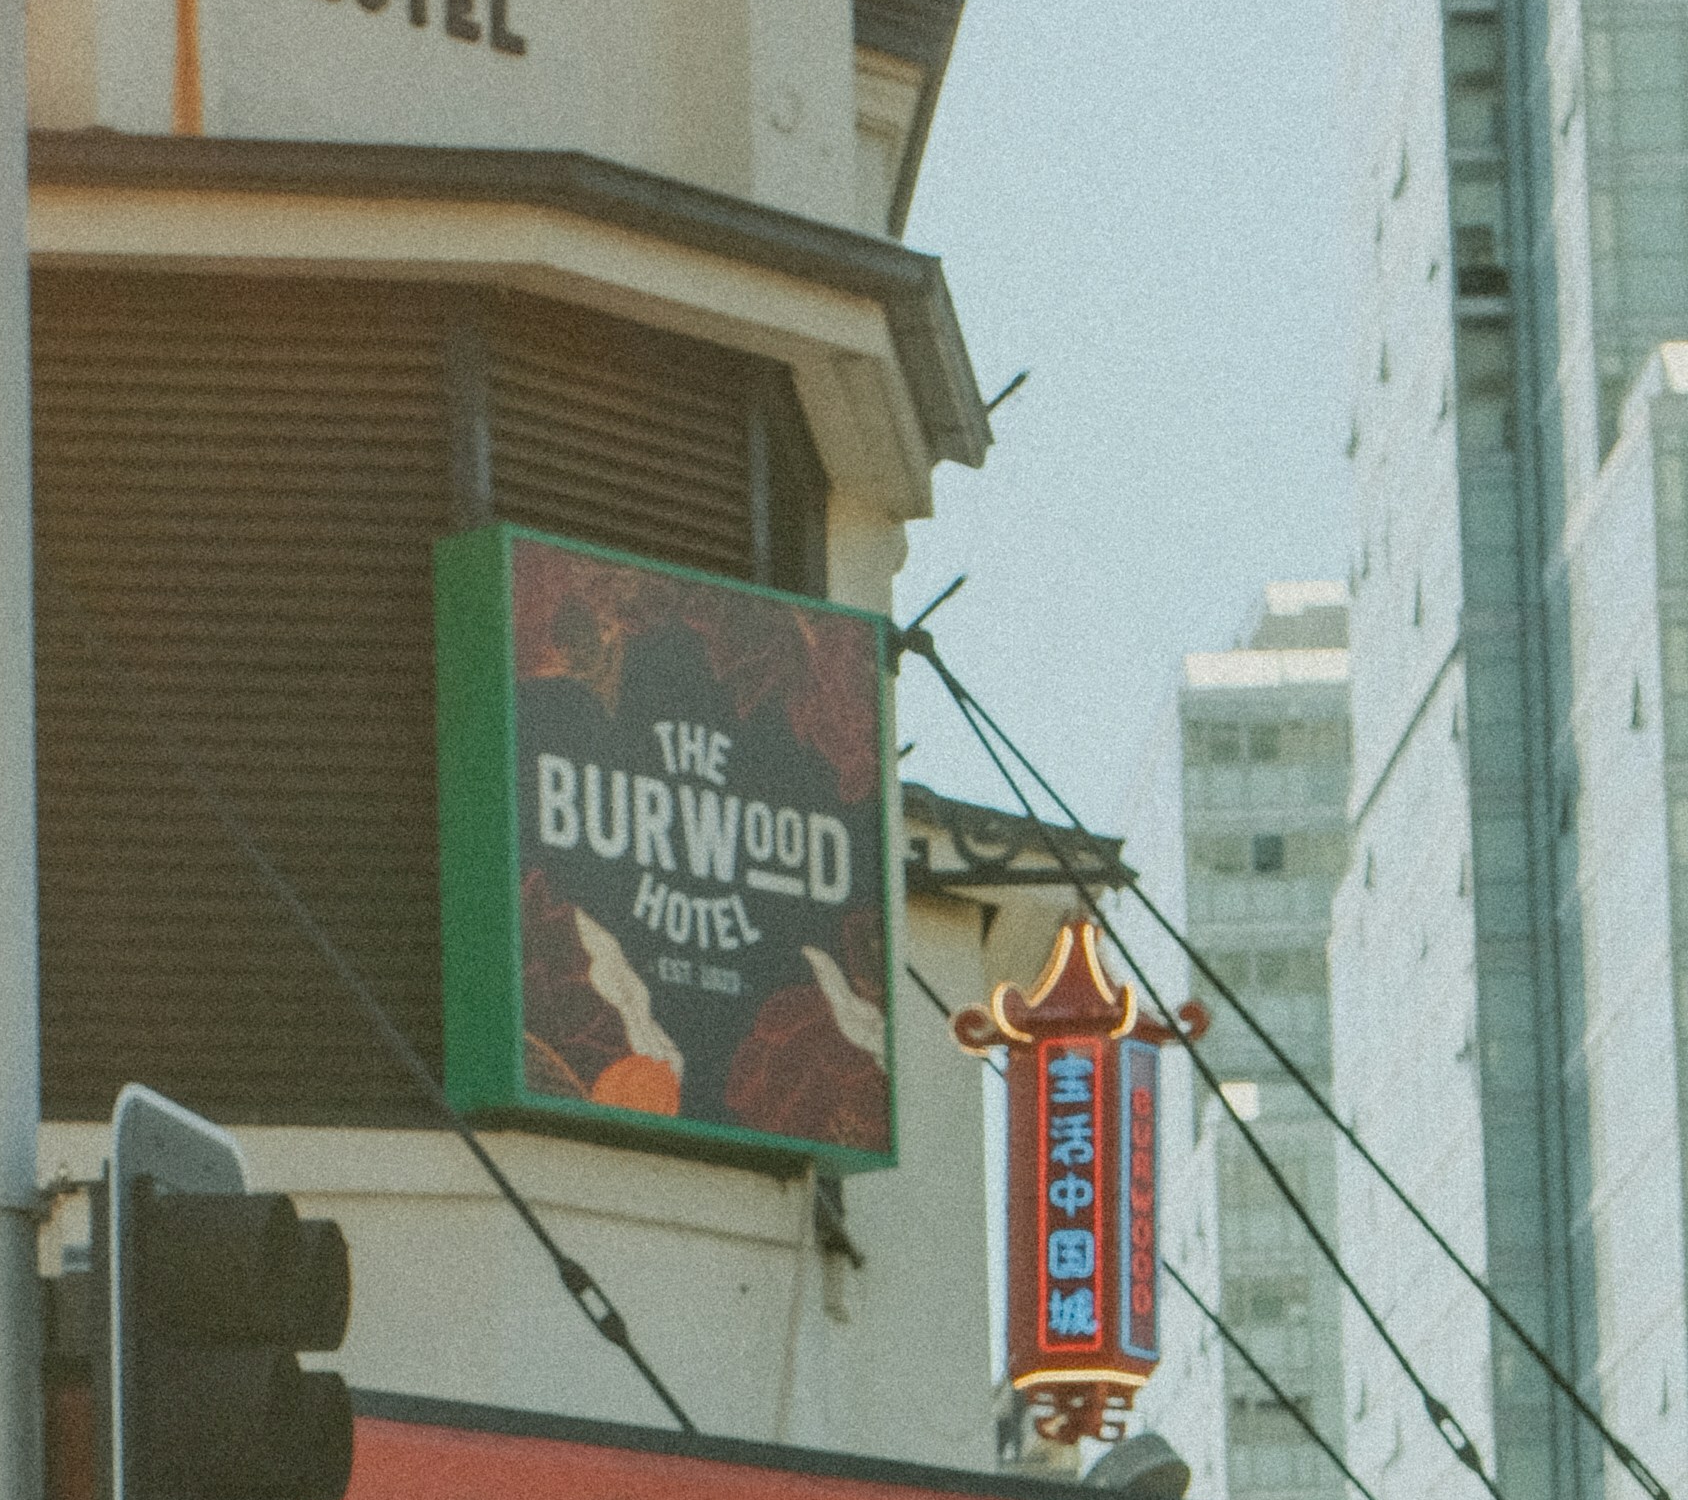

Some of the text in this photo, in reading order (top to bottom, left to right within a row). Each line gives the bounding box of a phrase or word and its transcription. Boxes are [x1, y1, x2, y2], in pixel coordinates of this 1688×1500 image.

[653, 719, 732, 787] THE
[536, 751, 853, 905] BURWOOD
[632, 871, 763, 954] HOTEL
